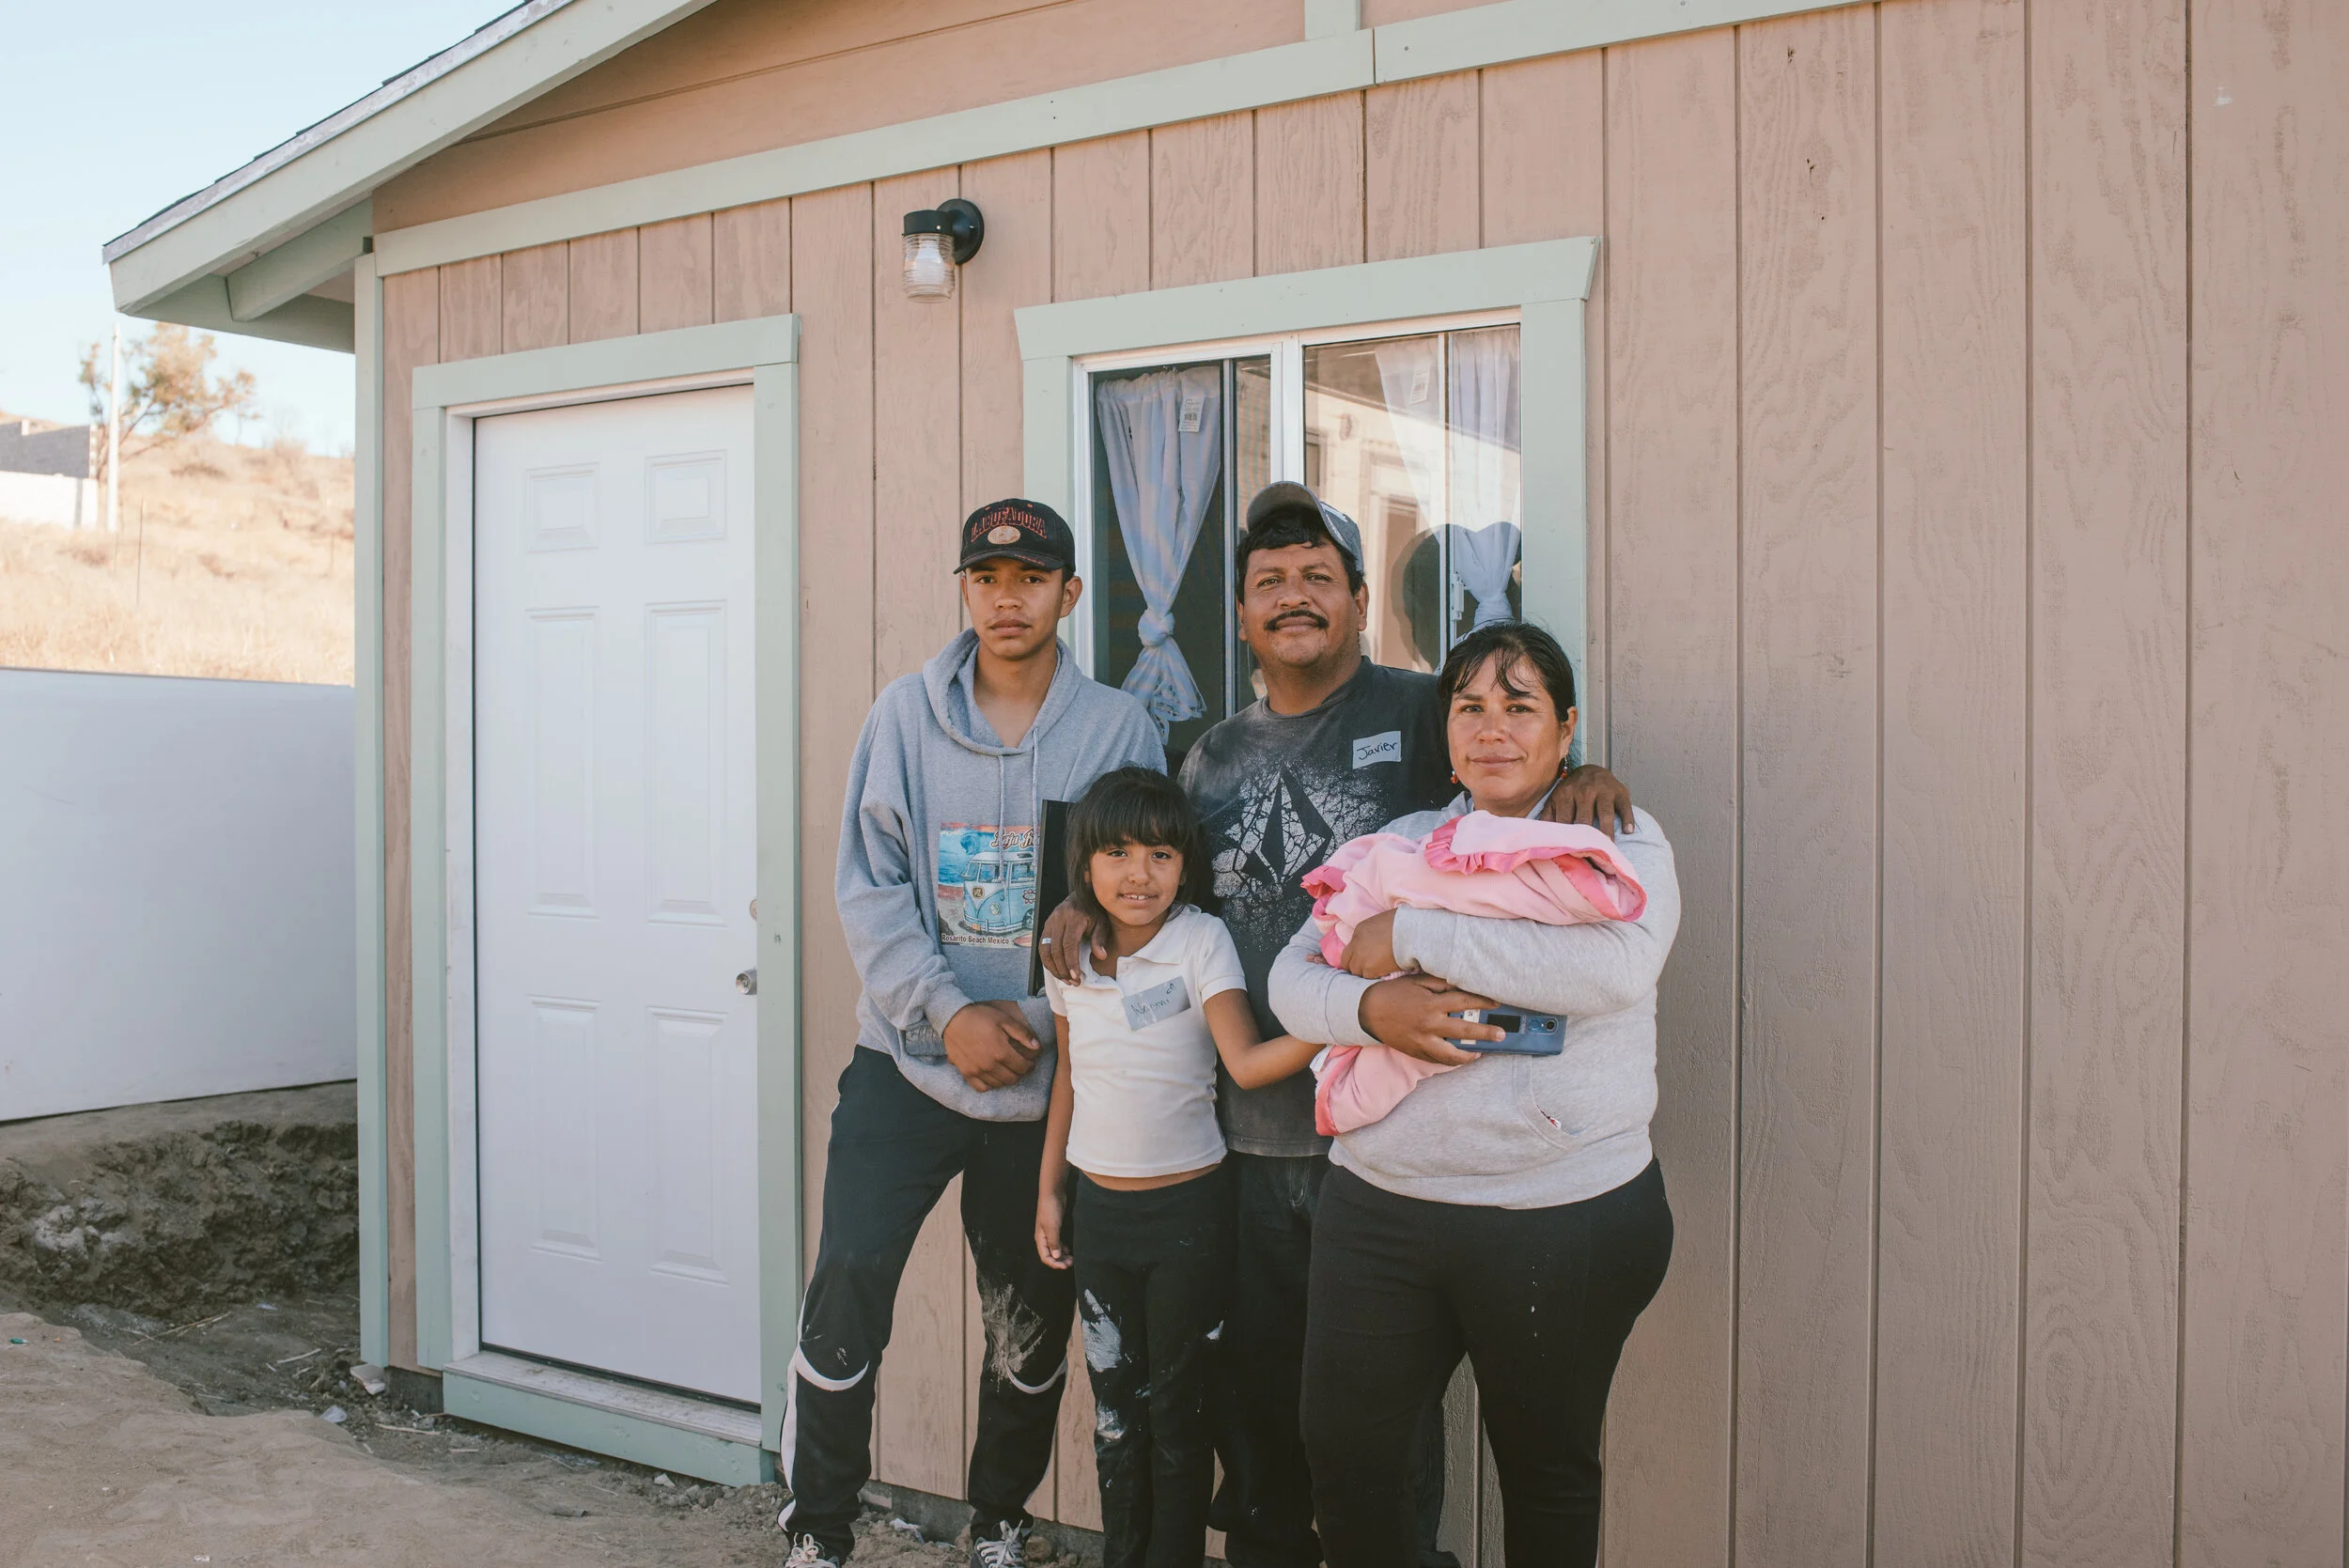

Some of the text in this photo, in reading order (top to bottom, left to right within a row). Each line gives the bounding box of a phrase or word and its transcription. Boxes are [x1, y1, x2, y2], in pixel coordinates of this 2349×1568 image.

[1356, 742, 1398, 760] Javier
[941, 934, 1010, 944] Rosarito Beach Mexico
